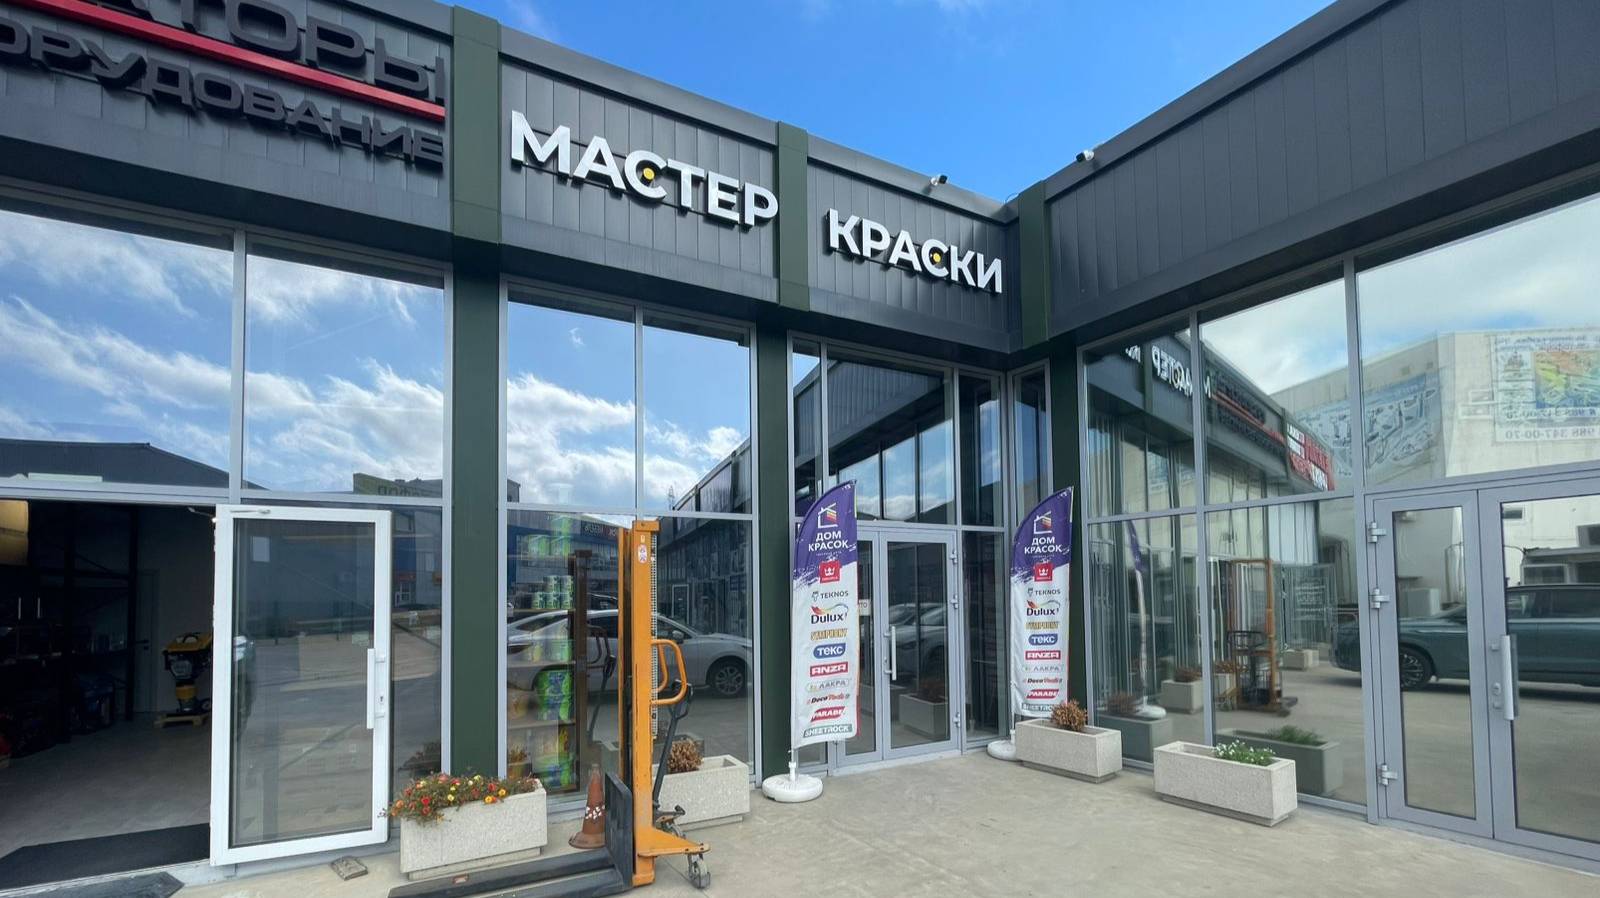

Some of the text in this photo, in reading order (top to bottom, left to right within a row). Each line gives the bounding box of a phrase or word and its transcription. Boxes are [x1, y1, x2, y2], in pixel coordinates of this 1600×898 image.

[510, 110, 779, 227] МАСТЕР
[828, 208, 1002, 293] КРАСКИ
[815, 530, 842, 542] ДОМ
[1031, 536, 1055, 546] ДОМ
[808, 540, 849, 552] КРАСОК
[1024, 544, 1062, 555] КРАСОК
[820, 590, 849, 599] TEKNOS
[1026, 608, 1056, 616] Dulux
[811, 613, 844, 625] Dulux
[1026, 651, 1060, 659] ANZA
[811, 664, 847, 676] ANZA
